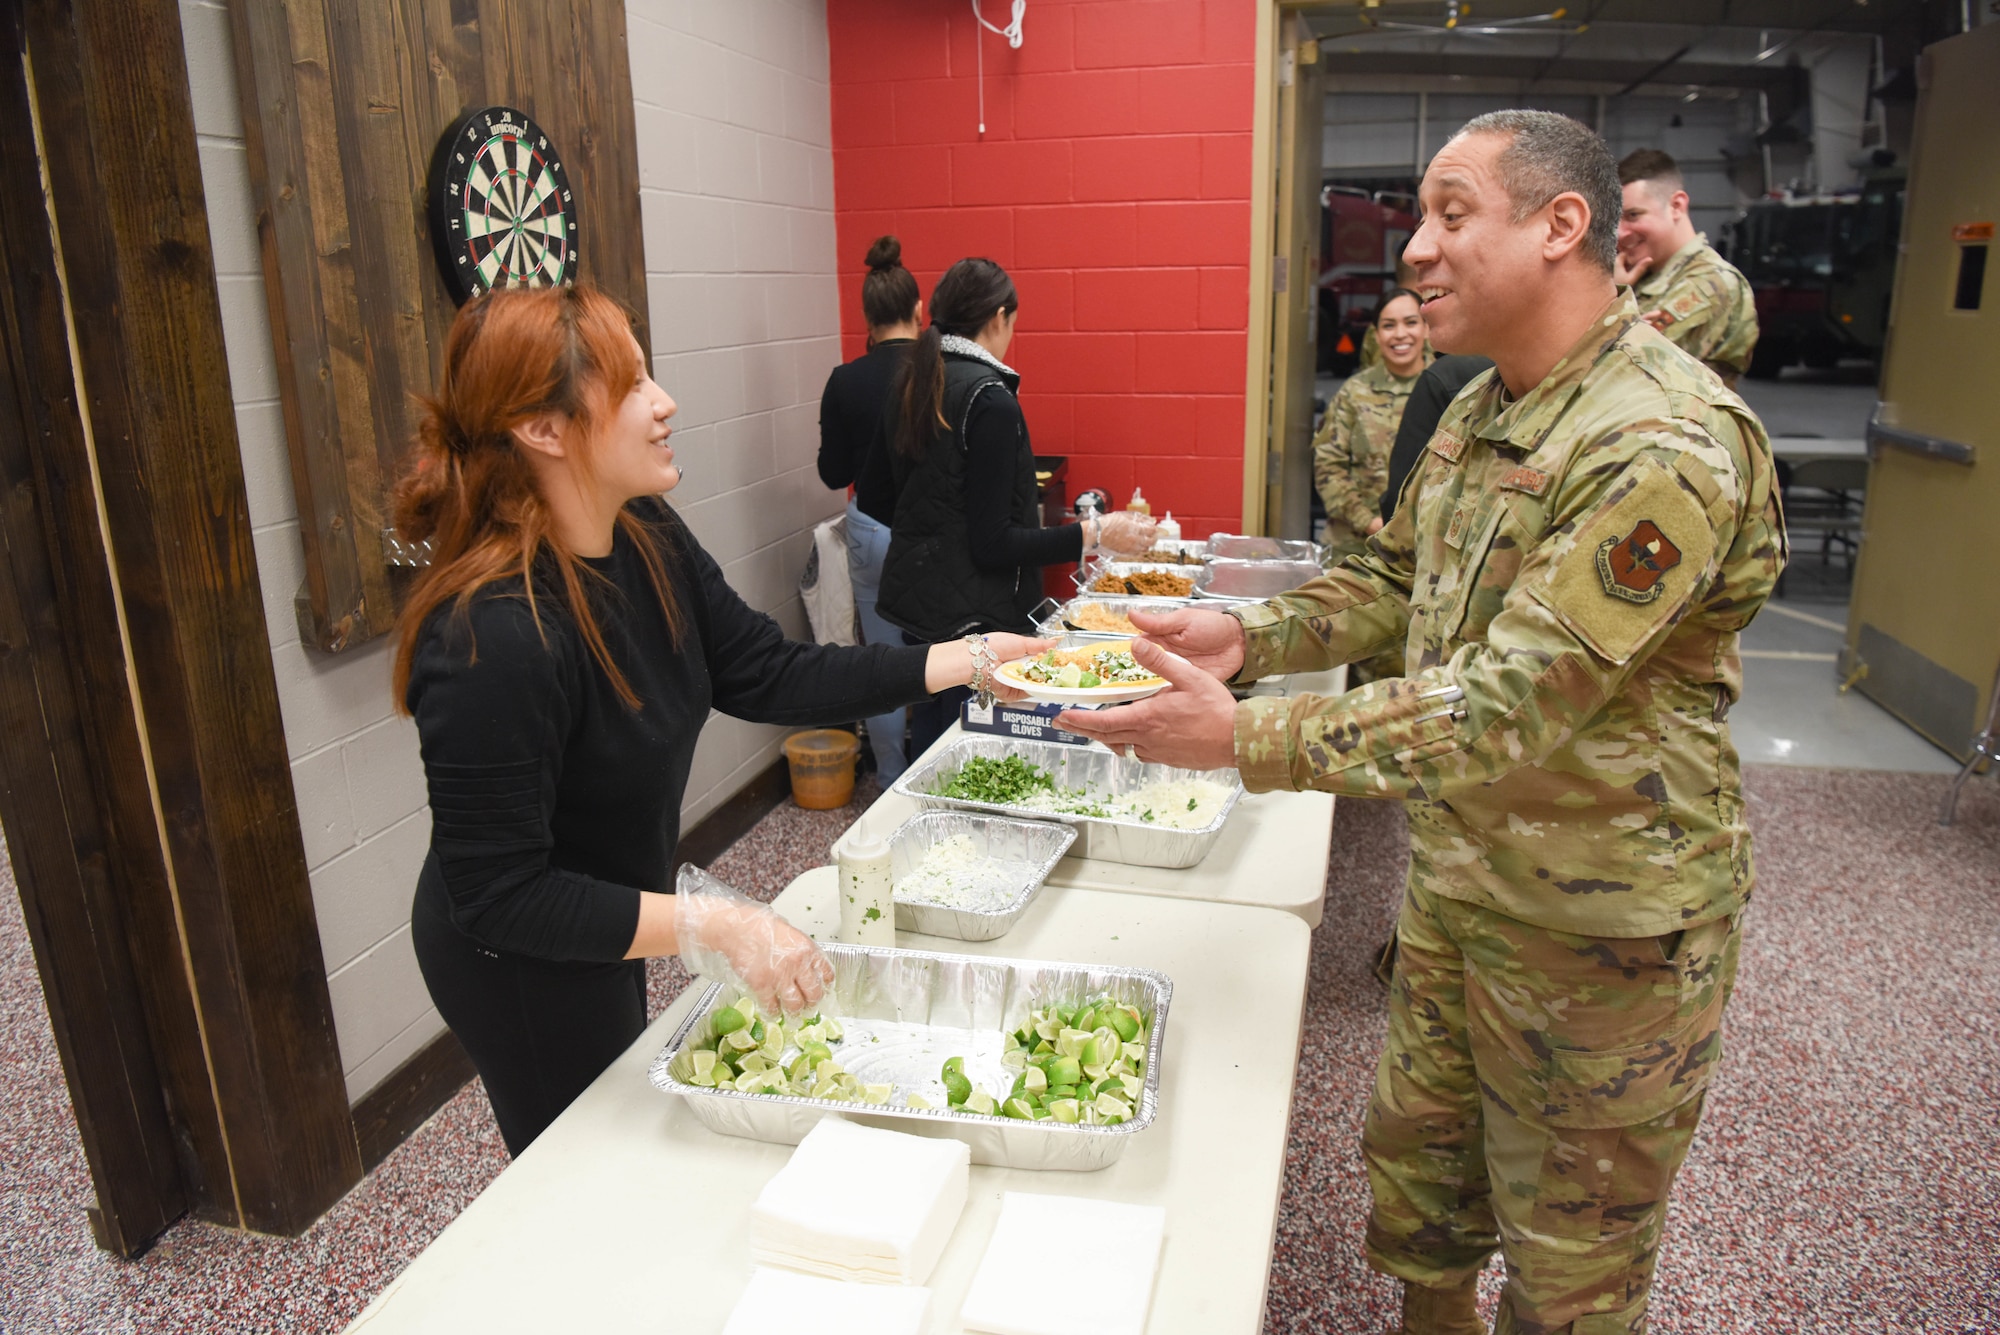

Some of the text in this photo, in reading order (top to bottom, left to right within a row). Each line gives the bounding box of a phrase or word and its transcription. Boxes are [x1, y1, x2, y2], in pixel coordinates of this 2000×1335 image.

[485, 114, 492, 127] 5
[467, 127, 478, 142] 12
[539, 136, 547, 150] 18
[456, 152, 465, 165] 9
[553, 162, 560, 172] 4
[450, 182, 459, 196] 14
[451, 219, 460, 230] 11
[458, 255, 467, 265] 8
[471, 283, 481, 298] 16
[1002, 711, 1052, 728] DISPOSABLE
[1011, 723, 1042, 737] GLOVES
